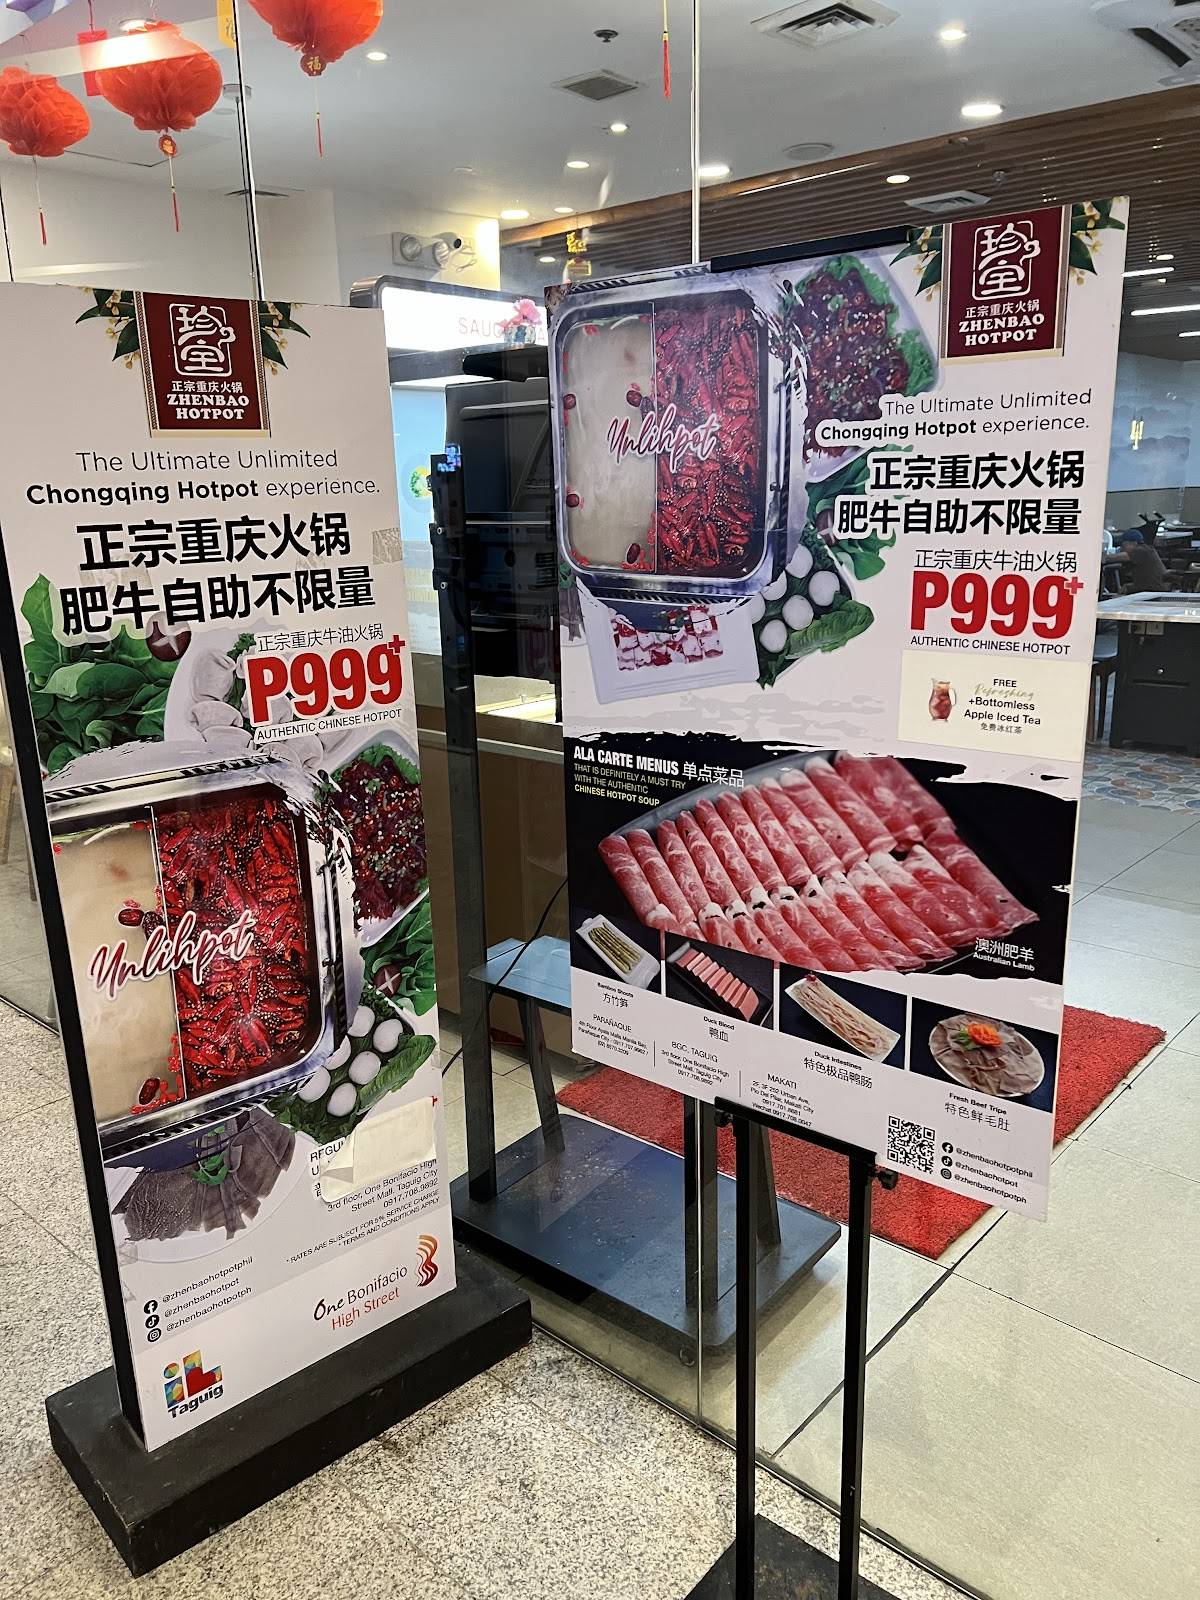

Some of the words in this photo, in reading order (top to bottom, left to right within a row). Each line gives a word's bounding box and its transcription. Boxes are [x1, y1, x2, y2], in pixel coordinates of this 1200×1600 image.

[965, 299, 1040, 319] 正宗重庆火锅
[959, 313, 1045, 333] ZHENBAO
[965, 329, 1037, 346] HOTPOT
[166, 393, 250, 406] ZHENBAO
[171, 380, 244, 394] 正宗重庆火锅
[175, 407, 245, 420] HOTPOT
[885, 401, 915, 416] The
[921, 398, 994, 414] Ultimate
[1000, 389, 1092, 409] Unlimited
[821, 422, 909, 441] Chongqing
[915, 420, 977, 438] Hotpot
[982, 415, 1090, 433] experience.
[76, 451, 123, 472] The
[131, 450, 230, 471] Ultimate
[238, 449, 338, 469] Unlimited
[869, 450, 1084, 490] 正宗重庆火锅
[26, 481, 171, 506] Chongqing
[178, 480, 258, 502] Hotpot
[266, 477, 380, 498] experience.
[837, 498, 1082, 535] 肥牛自助不限量
[76, 512, 351, 571] 正宗重庆火锅
[914, 549, 1077, 573] 正宗重庆牛油火锅
[59, 565, 376, 635] 肥牛自助不限量
[257, 623, 384, 652] 正宗重庆牛油火锅
[910, 635, 969, 648] AUTHENTIC
[972, 639, 1020, 652] CHINESE
[1023, 643, 1071, 655] HOTPOT
[993, 678, 1017, 688] FREE
[257, 722, 316, 740] AUTHENTIC
[318, 714, 361, 730] CHINESE
[363, 708, 402, 723] HOTPOT
[964, 709, 994, 721] Apple
[997, 712, 1020, 723] Iced
[1022, 714, 1041, 725] Tea
[980, 722, 1023, 735] 免费冰红茶
[574, 746, 595, 762] ALA
[598, 749, 633, 768] CARTE
[636, 755, 679, 776] MENUS
[682, 761, 744, 788] 单点菜品
[574, 763, 591, 773] THAT
[592, 766, 599, 775] IS
[600, 767, 639, 781] DEFINITELY
[641, 774, 647, 783] A
[647, 775, 669, 787] MUST
[670, 779, 686, 789] TRY
[574, 773, 591, 783] WITH
[593, 776, 607, 786] THE
[607, 779, 648, 794] AUTHENTIC
[574, 784, 605, 797] CHINESE
[606, 790, 637, 803] HOTPOT
[638, 795, 660, 806] SOUP
[973, 951, 1011, 967] Australian
[1012, 960, 1035, 971] Lamb
[975, 937, 1034, 962] 澳洲肥羊
[593, 1013, 632, 1033] PARAÑAQUE
[703, 1016, 717, 1025] Duck
[718, 1020, 735, 1030] Blood
[691, 1047, 718, 1063] TAGUIG
[814, 1051, 830, 1061] Duck
[831, 1056, 862, 1071] Intestines
[767, 1073, 797, 1090] MAKATI
[803, 1057, 873, 1089] 特色极品鸭肠
[944, 1101, 1011, 1132] 特色鲜毛肚
[949, 1092, 969, 1104] Fresh
[970, 1098, 988, 1110] Beef
[989, 1104, 1007, 1115] Tripe
[955, 1160, 1018, 1188] @zhenbaohotpot
[956, 1146, 1034, 1178] @zhenbaohotpotphil
[351, 1197, 375, 1213] Street
[396, 1174, 421, 1191] Taguig
[423, 1168, 438, 1182] City
[365, 1183, 381, 1195] One
[382, 1167, 418, 1188] Bonifacio
[383, 1178, 438, 1208] 0917.708.9892
[954, 1173, 1027, 1204] @zhenbaohotpotph
[290, 1249, 312, 1264] RATES
[314, 1240, 327, 1253] ARE
[329, 1228, 358, 1245] SUBJECT
[360, 1219, 374, 1231] FOR
[374, 1215, 385, 1224] 5%
[386, 1203, 412, 1218] SERVICE
[413, 1189, 439, 1205] CHARGE
[342, 1231, 366, 1247] TERMS
[366, 1223, 381, 1235] AND
[381, 1205, 420, 1228] CONDITIONS
[421, 1196, 440, 1210] APPLY
[162, 1256, 253, 1303] @zhenbaohotpotphil
[164, 1278, 240, 1318] @zhenbaohotpot
[313, 1298, 345, 1321] One
[347, 1266, 408, 1305] Bonifacio
[166, 1287, 252, 1332] @zhenbaohotpotph
[331, 1307, 360, 1330] High
[364, 1288, 400, 1313] Street
[168, 1384, 224, 1419] Taguig
